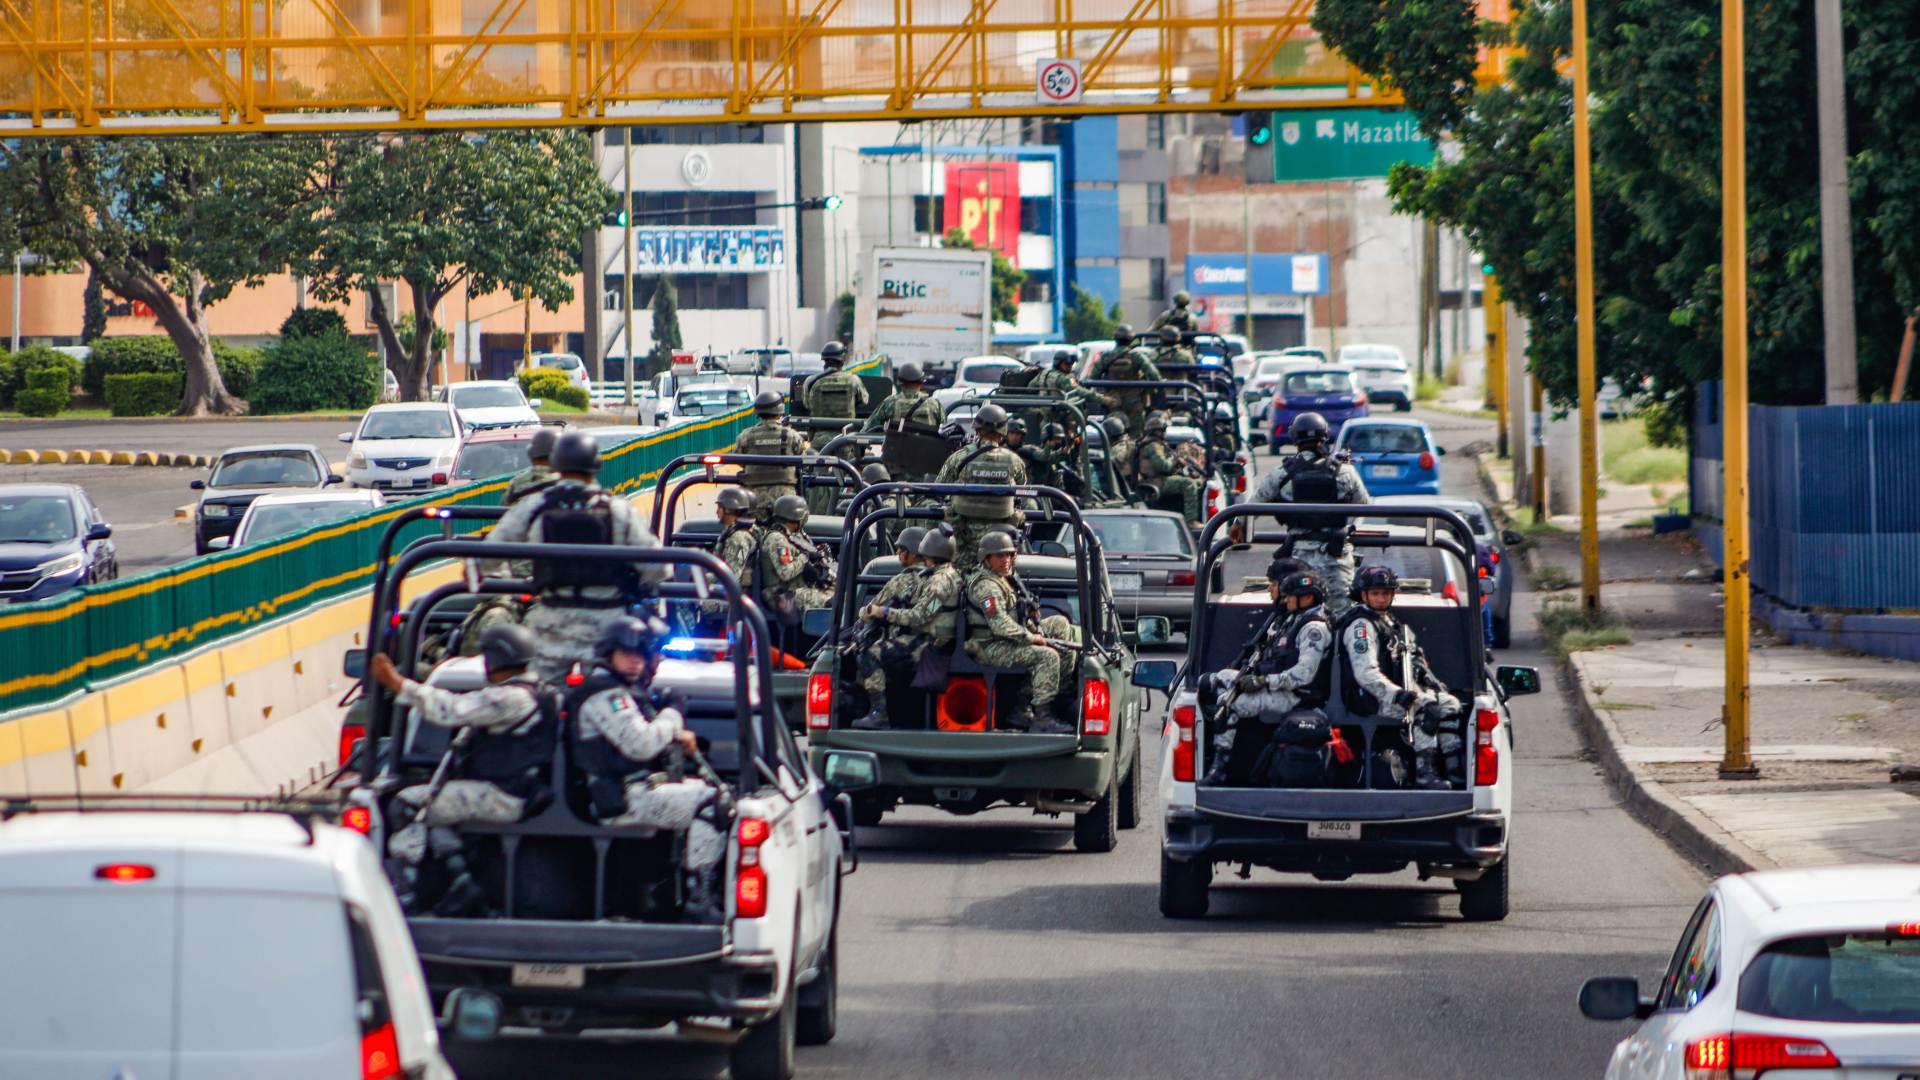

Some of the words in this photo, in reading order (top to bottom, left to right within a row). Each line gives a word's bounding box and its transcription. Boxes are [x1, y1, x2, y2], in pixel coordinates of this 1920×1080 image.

[1343, 120, 1428, 143] Mazatlá
[961, 197, 1003, 243] PT
[883, 280, 927, 298] Pitic
